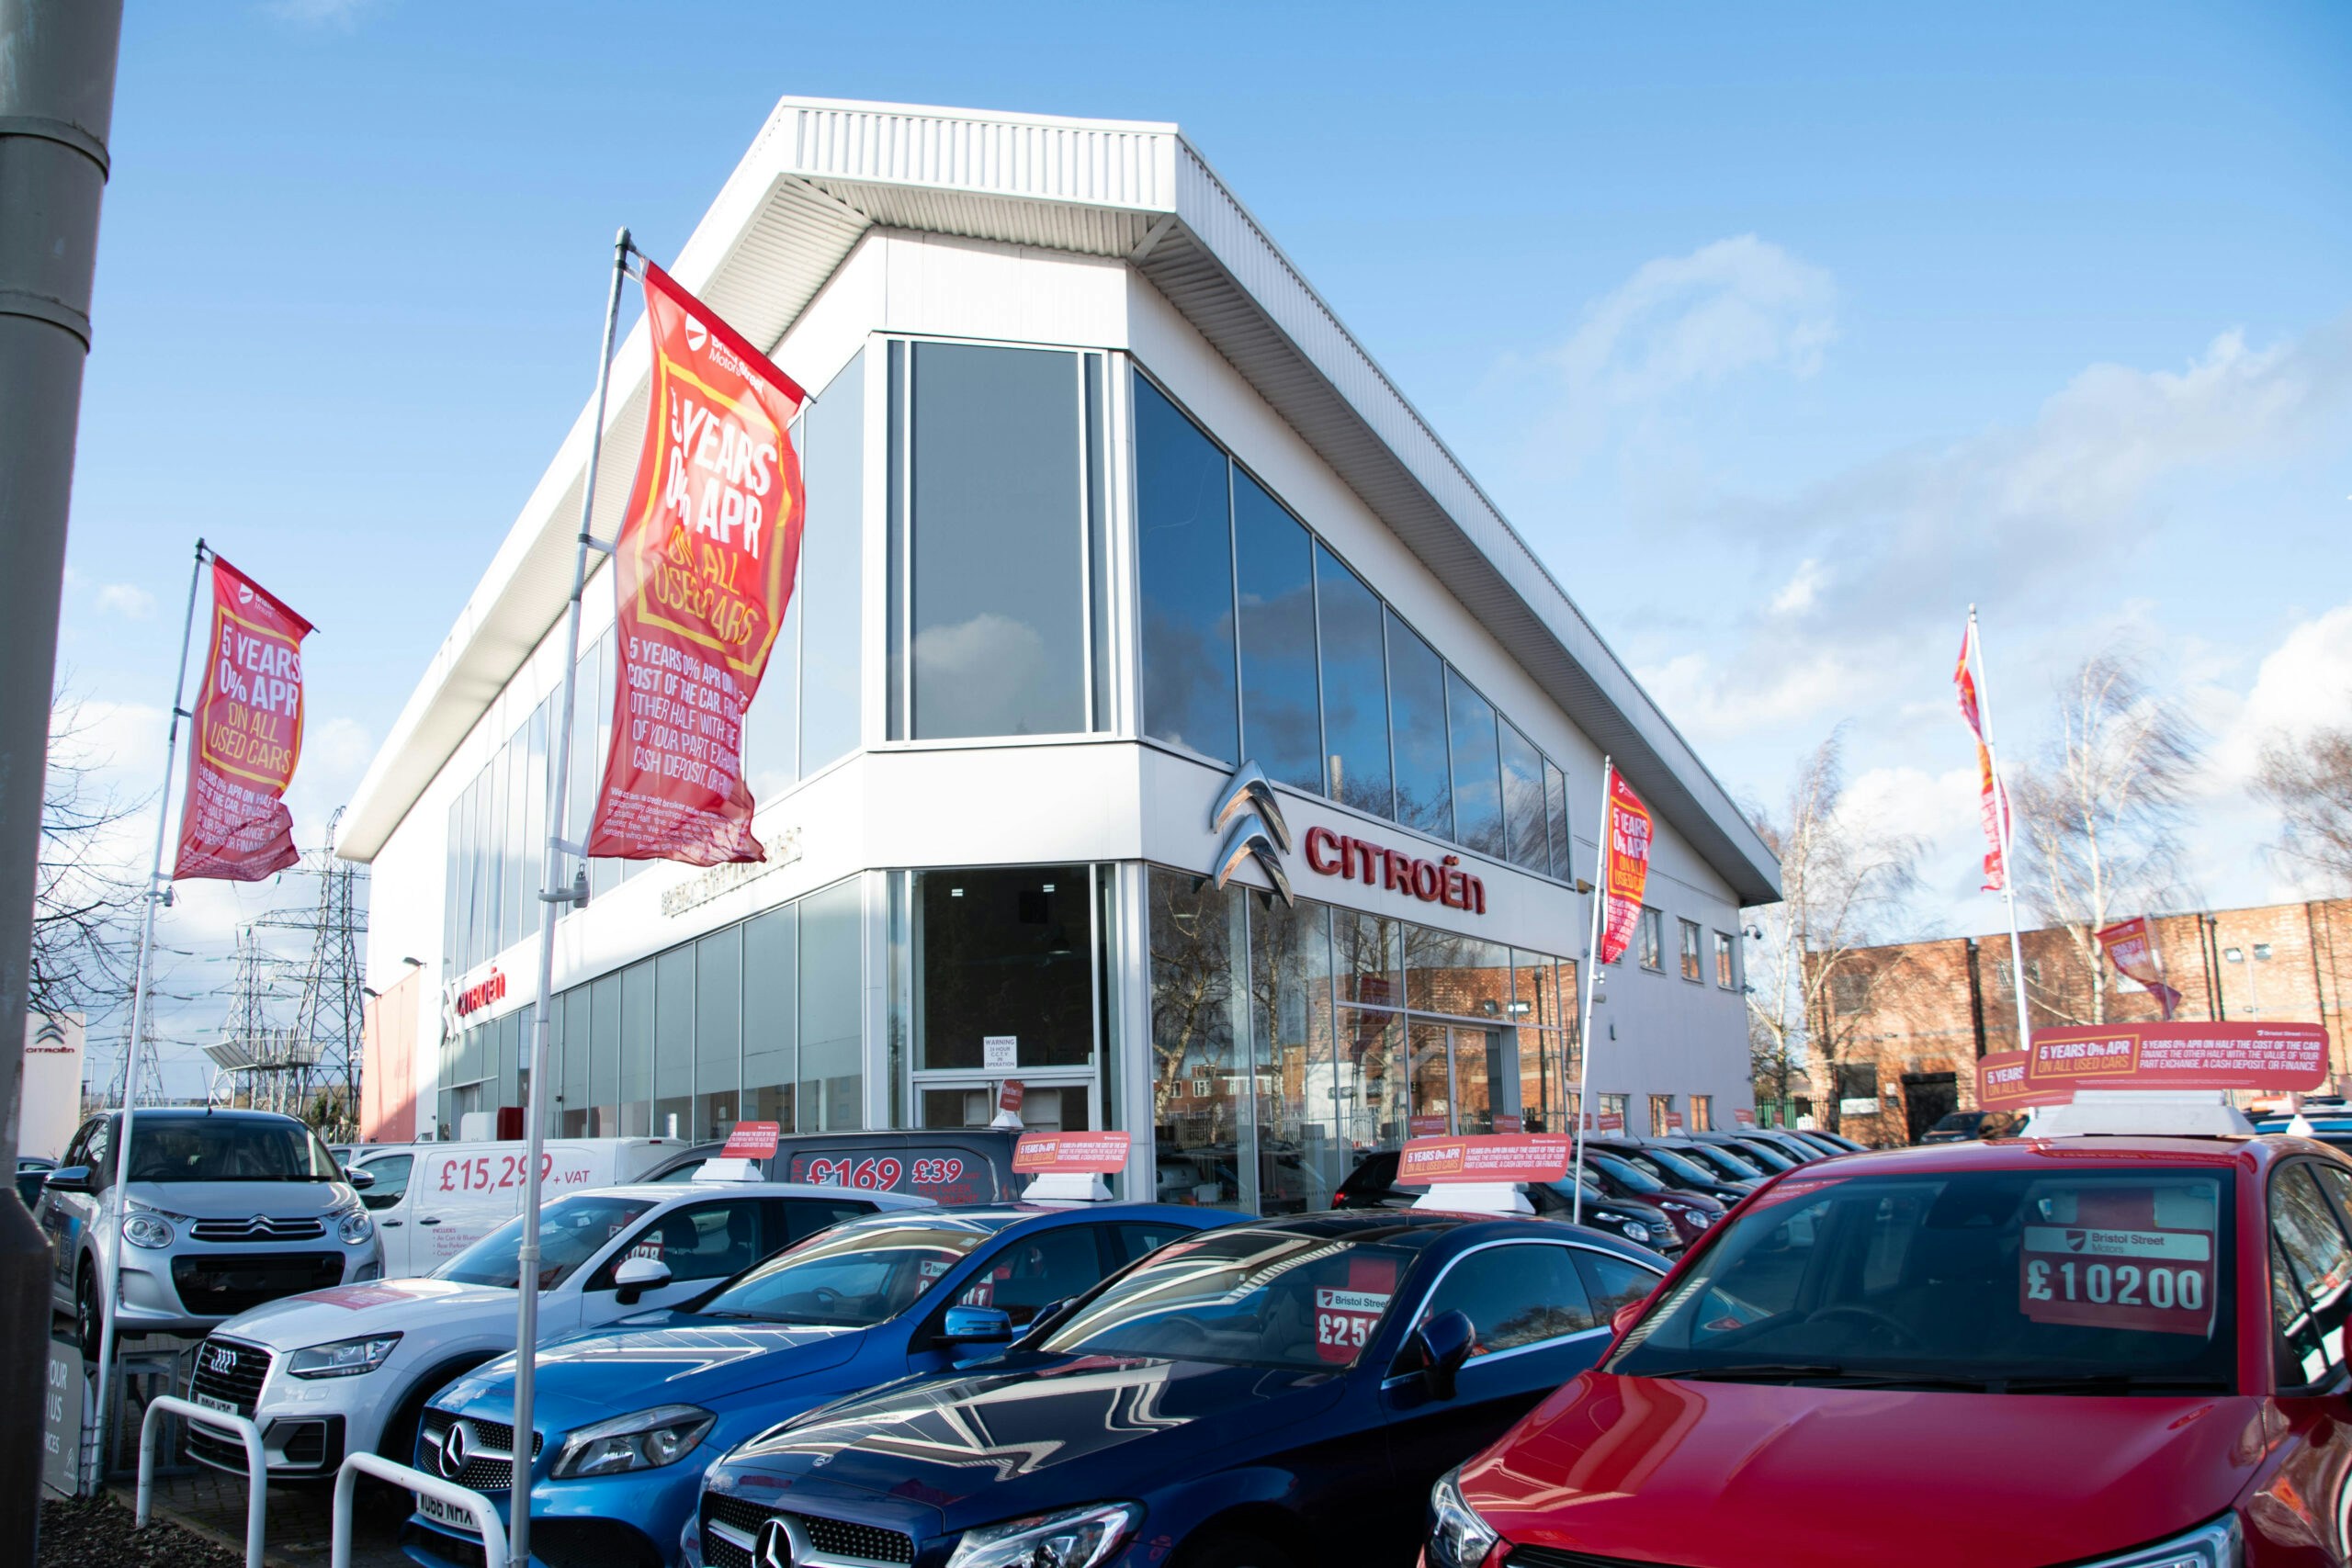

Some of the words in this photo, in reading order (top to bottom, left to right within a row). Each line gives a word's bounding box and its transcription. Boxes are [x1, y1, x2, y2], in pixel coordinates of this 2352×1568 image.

[708, 347, 741, 377] Motors
[682, 399, 777, 497] YEARS
[696, 477, 763, 559] APR
[702, 543, 741, 596] ALL
[221, 625, 232, 658] 5
[237, 632, 301, 683] YEARS
[629, 637, 639, 659] 5
[642, 639, 683, 671] YEARS
[683, 654, 700, 681] 0%
[702, 662, 720, 689] APR
[220, 659, 247, 703] 0%
[251, 674, 300, 720] APR
[628, 662, 662, 691] COST
[664, 672, 678, 696] OF
[680, 677, 697, 705] THE
[228, 702, 248, 731] ON
[250, 711, 278, 743] ALL
[630, 691, 671, 722] OTHER
[671, 703, 695, 730] HALF
[210, 721, 247, 760] USED
[246, 739, 292, 774] CARS
[632, 719, 649, 742] OF
[649, 722, 679, 750] YOUR
[682, 732, 709, 760] PART
[633, 745, 661, 773] CASH
[212, 790, 224, 807] THE
[227, 784, 243, 799] APR
[243, 790, 254, 804] ON
[1613, 807, 1620, 828] 5
[1621, 812, 1648, 838] YEARS
[1627, 835, 1648, 862] APR
[2040, 1045, 2049, 1059] 5
[2050, 1043, 2086, 1059] YEARS
[2086, 1043, 2105, 1056] 0%
[2106, 1040, 2131, 1055] APR
[2142, 1041, 2148, 1049] 5
[2149, 1040, 2172, 1049] YEARS
[2187, 1040, 2202, 1049] APR
[2215, 1040, 2235, 1049] HALF
[2236, 1040, 2251, 1049] THE
[2252, 1041, 2273, 1050] COST
[2274, 1041, 2285, 1050] OF
[2286, 1041, 2301, 1050] THE
[2302, 1042, 2321, 1051] CAR
[2170, 1049, 2182, 1058] THE
[2183, 1049, 2206, 1058] OTHER
[2207, 1050, 2225, 1058] HALF
[2247, 1050, 2262, 1059] THE
[2263, 1051, 2286, 1059] VALUE
[2287, 1051, 2297, 1060] OF
[2298, 1052, 2319, 1060] YOUR
[1987, 1072, 1995, 1084] 5
[1996, 1066, 2025, 1083] YEARS
[2038, 1060, 2052, 1073] ON
[2053, 1059, 2071, 1072] ALL
[2074, 1057, 2100, 1070] USED
[2101, 1055, 2129, 1069] CARS
[2139, 1059, 2159, 1068] PART
[2210, 1059, 2232, 1069] CASH
[2267, 1060, 2279, 1069] OR
[1988, 1084, 1998, 1096] ON
[2000, 1081, 2017, 1095] ALL
[1024, 1145, 1038, 1154] YEARS
[1046, 1143, 1056, 1152] APR
[1408, 1152, 1413, 1163] 5
[1414, 1150, 1435, 1162] YEARS
[1435, 1149, 1445, 1160] 0%
[1446, 1148, 1460, 1159] APR
[439, 1153, 553, 1194] £15,299
[564, 1169, 590, 1184] VAT
[807, 1157, 902, 1191] £169
[911, 1158, 963, 1183] £39
[1416, 1162, 1426, 1171] ALL
[1427, 1161, 1442, 1170] USED
[1442, 1159, 1459, 1169] CARS
[941, 1183, 971, 1193] WEEK
[2092, 1232, 2128, 1244] Bristol
[2132, 1234, 2165, 1246] Street
[2092, 1244, 2124, 1254] Motors
[2027, 1259, 2203, 1311] £10200
[1335, 1295, 1362, 1306] Bristol
[50, 1359, 68, 1390] OUR
